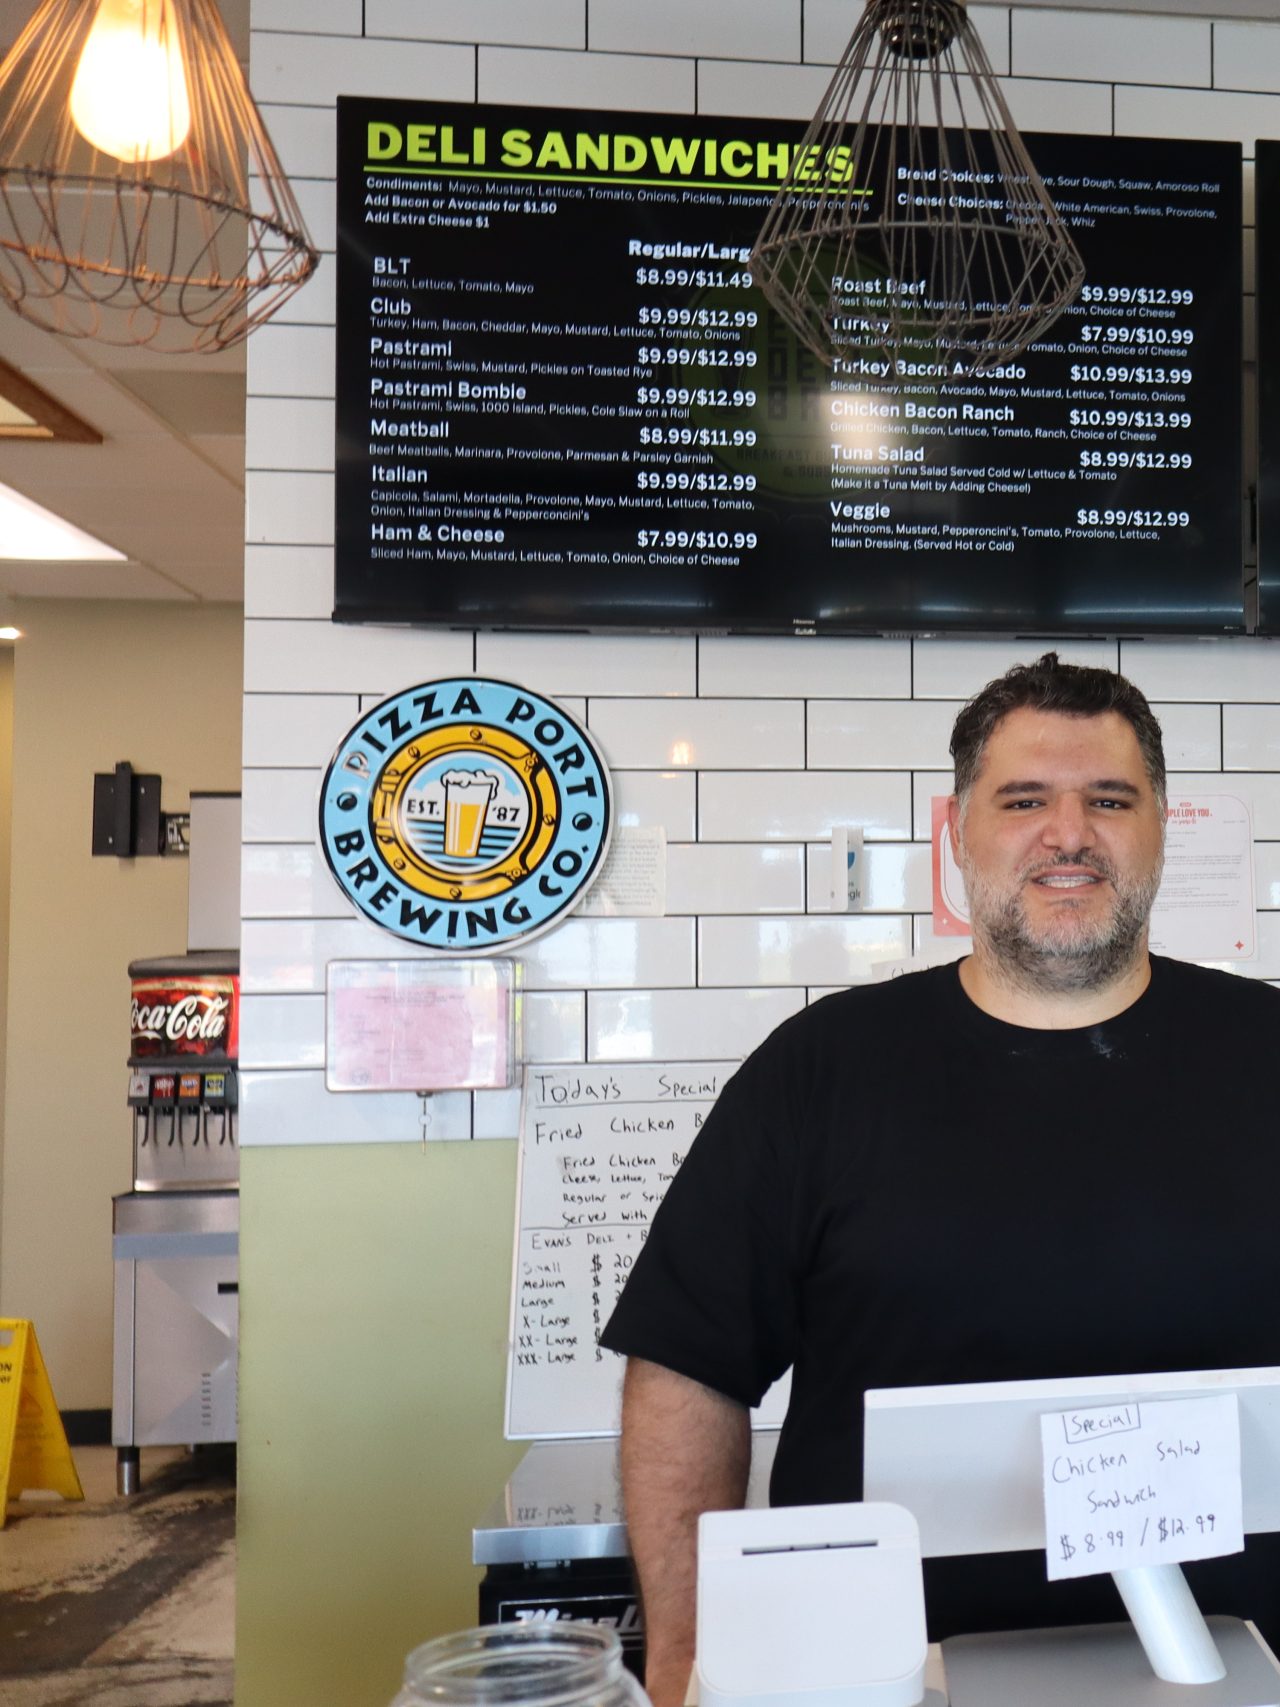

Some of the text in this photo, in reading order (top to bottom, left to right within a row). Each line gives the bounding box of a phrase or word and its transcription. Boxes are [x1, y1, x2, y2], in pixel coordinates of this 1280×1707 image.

[367, 121, 854, 183] DELI SANDWICHES
[364, 193, 557, 214] Add Bacon or Avocado for $1.50
[628, 239, 758, 263] Regular/Larg
[374, 256, 411, 275] BLT
[636, 267, 753, 289] $8.99/$11.49
[370, 296, 412, 315] Club
[638, 306, 758, 328] $9.99/$12.99
[370, 337, 452, 357] Pastrami
[638, 346, 757, 367] $9.99/$12.99
[371, 378, 453, 398] Pastrami
[637, 386, 757, 407] $9.99/$12.99
[830, 400, 1015, 421] Chicken Bacon Ranch
[1069, 408, 1192, 428] $10.99/$13.99
[371, 418, 449, 438] Meatball
[639, 426, 757, 447] $8.99/$11.99
[830, 443, 924, 462] Tuna Salad
[1079, 450, 1193, 469] $8.99/$12.99
[372, 464, 428, 483] Italian
[637, 471, 757, 492] $9.99/$12.99
[830, 500, 891, 521] Veggie
[1077, 508, 1190, 527] $8.99/$12.99
[371, 523, 505, 543] Ham & Cheese
[637, 529, 758, 549] $7.99/$10.99
[341, 687, 598, 799] PIZZA PORT
[406, 798, 521, 824] EST. '87
[333, 829, 590, 939] BREWING CO.
[534, 1074, 717, 1104] Today's Special
[535, 1117, 675, 1146] Fried Chicken
[563, 1154, 656, 1170] Fried Chicken
[562, 1192, 608, 1204] Regular
[621, 1210, 648, 1221] with
[522, 1279, 566, 1290] Medium
[521, 1296, 555, 1309] Large
[1071, 1407, 1133, 1437] Special
[1051, 1439, 1201, 1484] Chicken Salad
[1087, 1484, 1157, 1514] Sandwich
